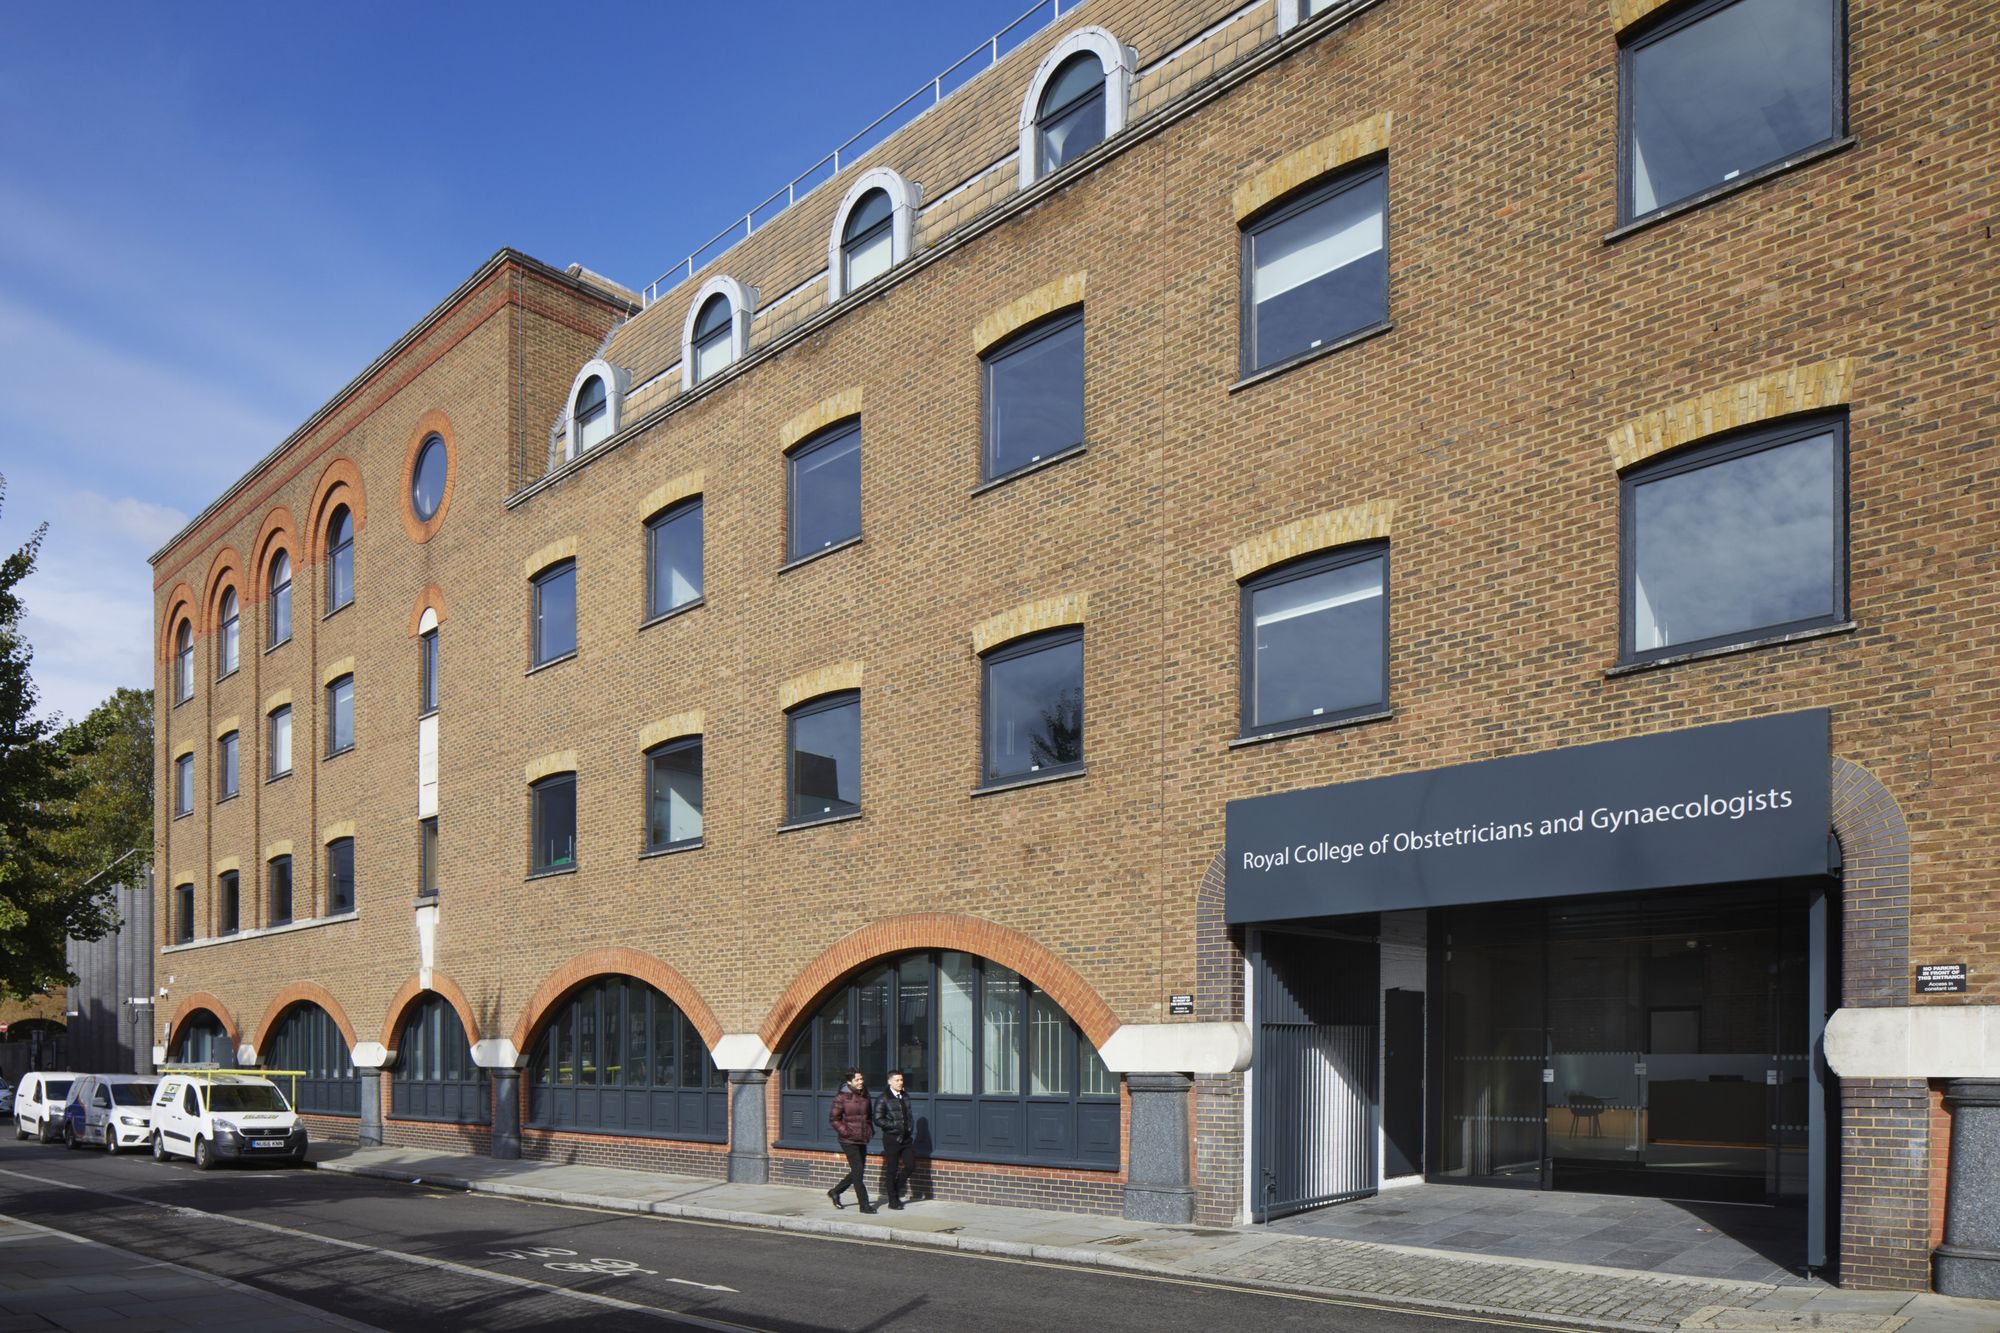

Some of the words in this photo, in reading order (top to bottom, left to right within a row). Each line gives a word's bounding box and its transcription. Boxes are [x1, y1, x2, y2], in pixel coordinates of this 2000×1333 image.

[1242, 846, 1290, 872] Royal
[1294, 841, 1365, 867] College
[1368, 833, 1389, 854] of
[1393, 821, 1534, 852] Obstetricians
[1539, 809, 1584, 836] and
[1590, 788, 1793, 833] Gynaecologists
